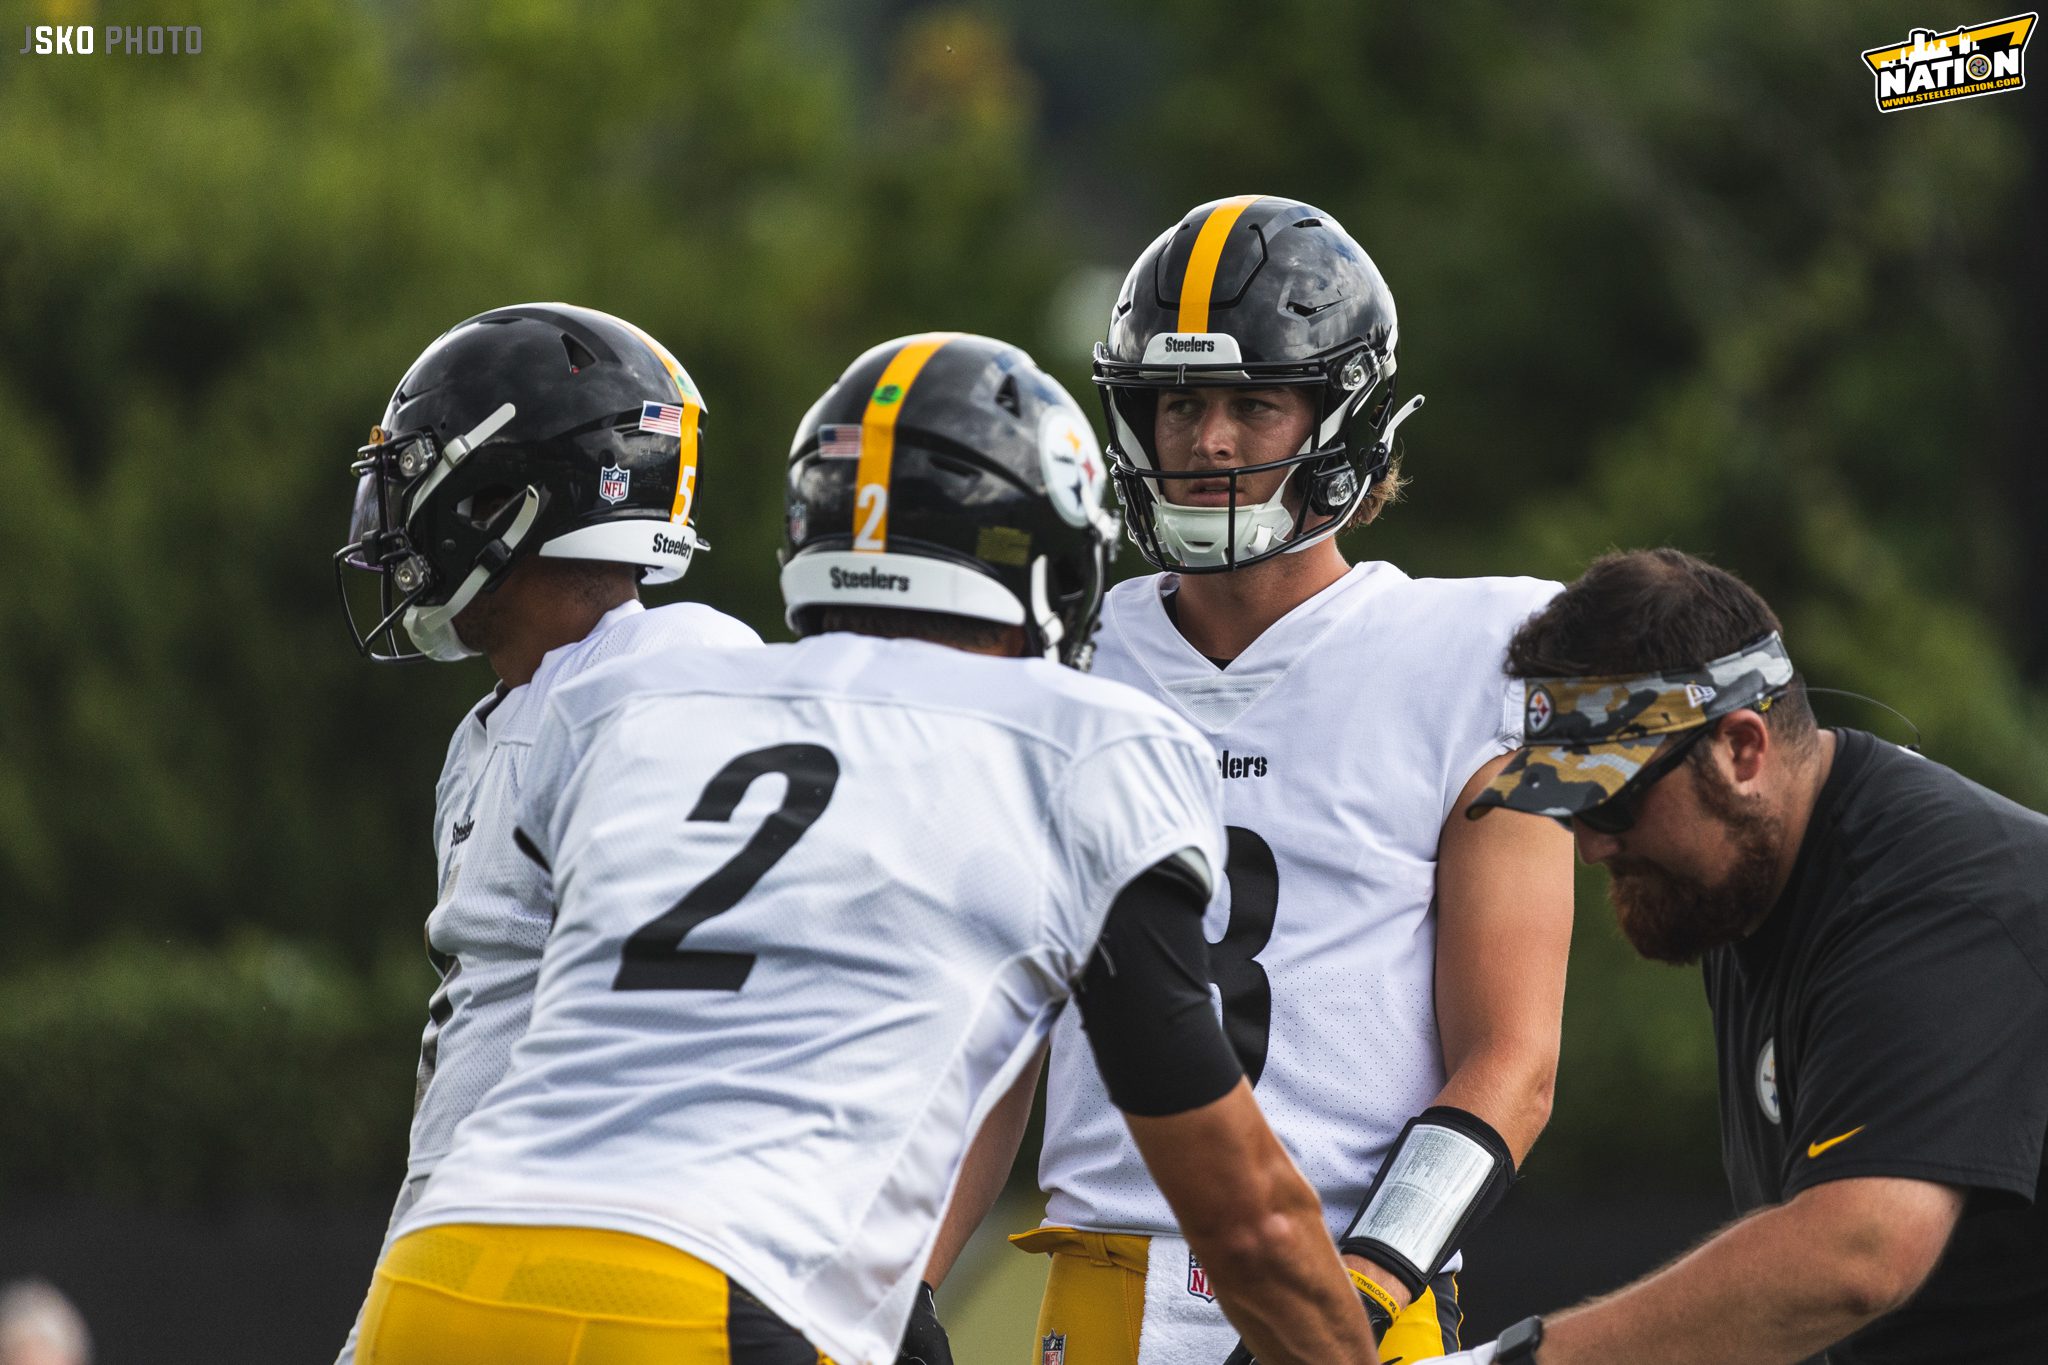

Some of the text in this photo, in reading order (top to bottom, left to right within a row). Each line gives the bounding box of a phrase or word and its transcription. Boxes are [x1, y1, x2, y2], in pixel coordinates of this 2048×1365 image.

[1165, 336, 1214, 352] Steelers
[604, 481, 624, 498] NFL
[672, 465, 696, 525] 5
[853, 484, 888, 550] 2
[830, 566, 910, 592] Steelers
[611, 742, 840, 992] 2
[1356, 1276, 1388, 1302] FOOTBALL
